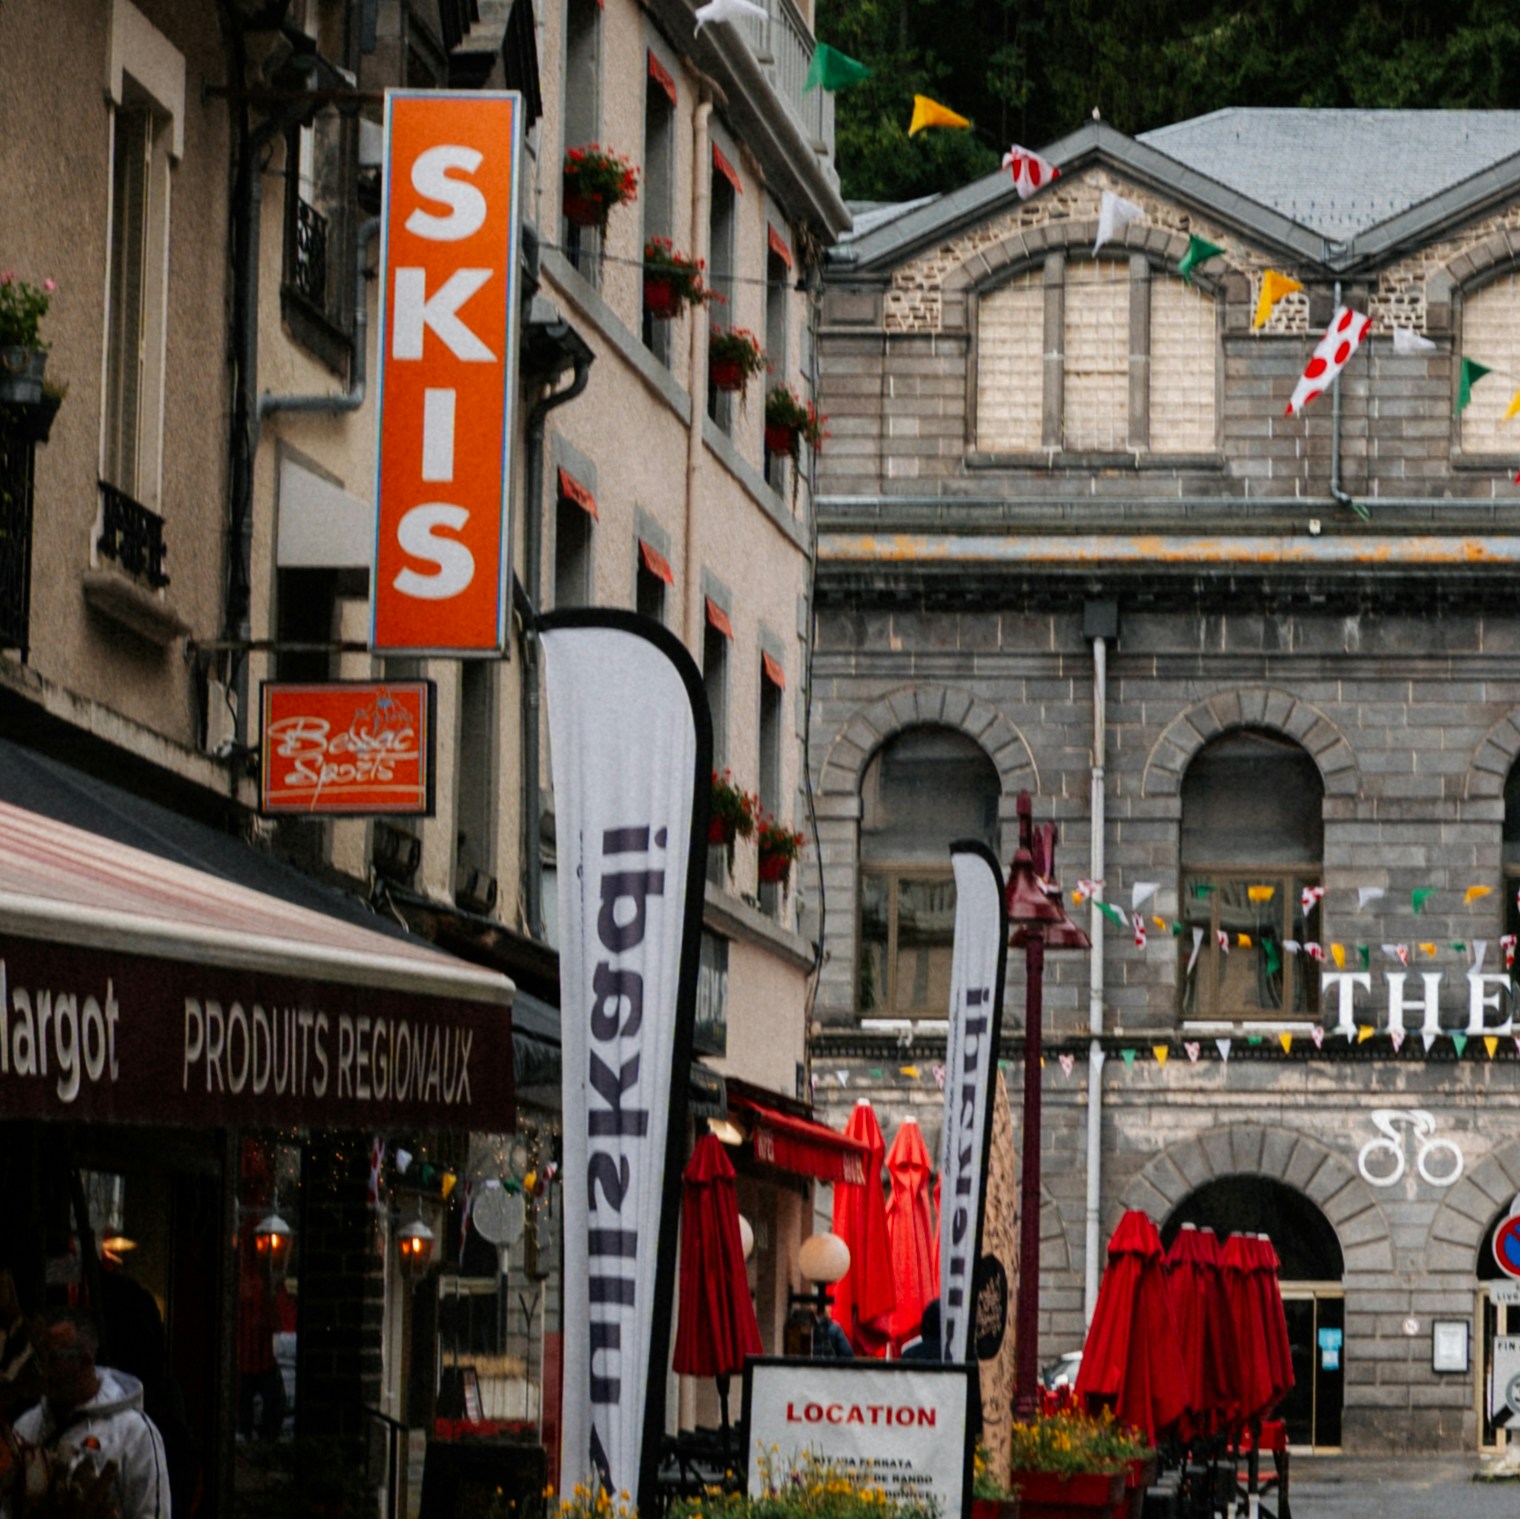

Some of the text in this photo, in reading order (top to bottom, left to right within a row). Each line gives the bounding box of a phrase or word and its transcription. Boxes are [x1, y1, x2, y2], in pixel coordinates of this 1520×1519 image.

[391, 144, 498, 600] SKIS
[268, 716, 416, 757] Bessac
[283, 751, 396, 811] Sports
[182, 996, 329, 1099] PRODUITS
[337, 1014, 474, 1105] REGIONAUX
[1497, 1340, 1516, 1351] FIN
[786, 1401, 938, 1428] LOCATION
[859, 1456, 913, 1470] FRRATA
[892, 1473, 934, 1485] RANDO
